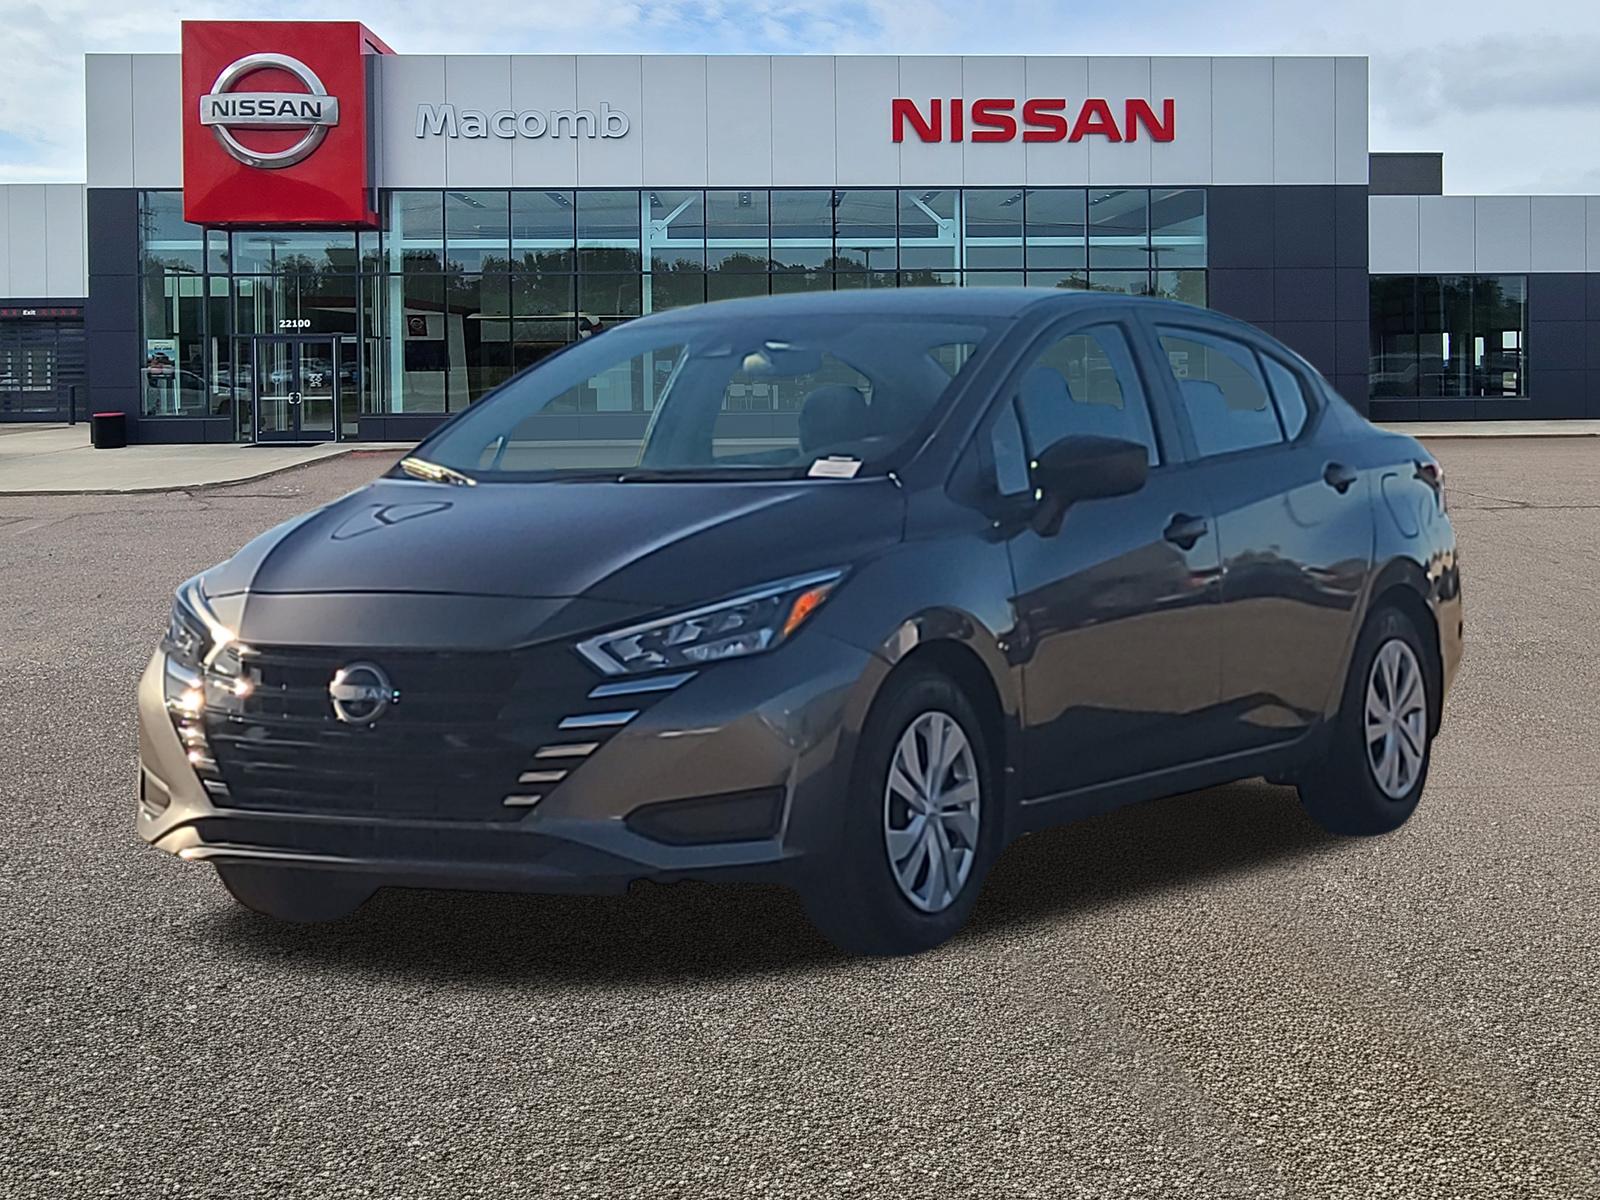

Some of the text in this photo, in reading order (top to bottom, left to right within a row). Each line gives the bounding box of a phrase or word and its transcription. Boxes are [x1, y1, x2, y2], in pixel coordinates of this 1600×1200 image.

[211, 100, 322, 118] NISSAN
[415, 102, 630, 139] Macomb
[892, 98, 1174, 142] NISSAN
[279, 319, 311, 328] 22100
